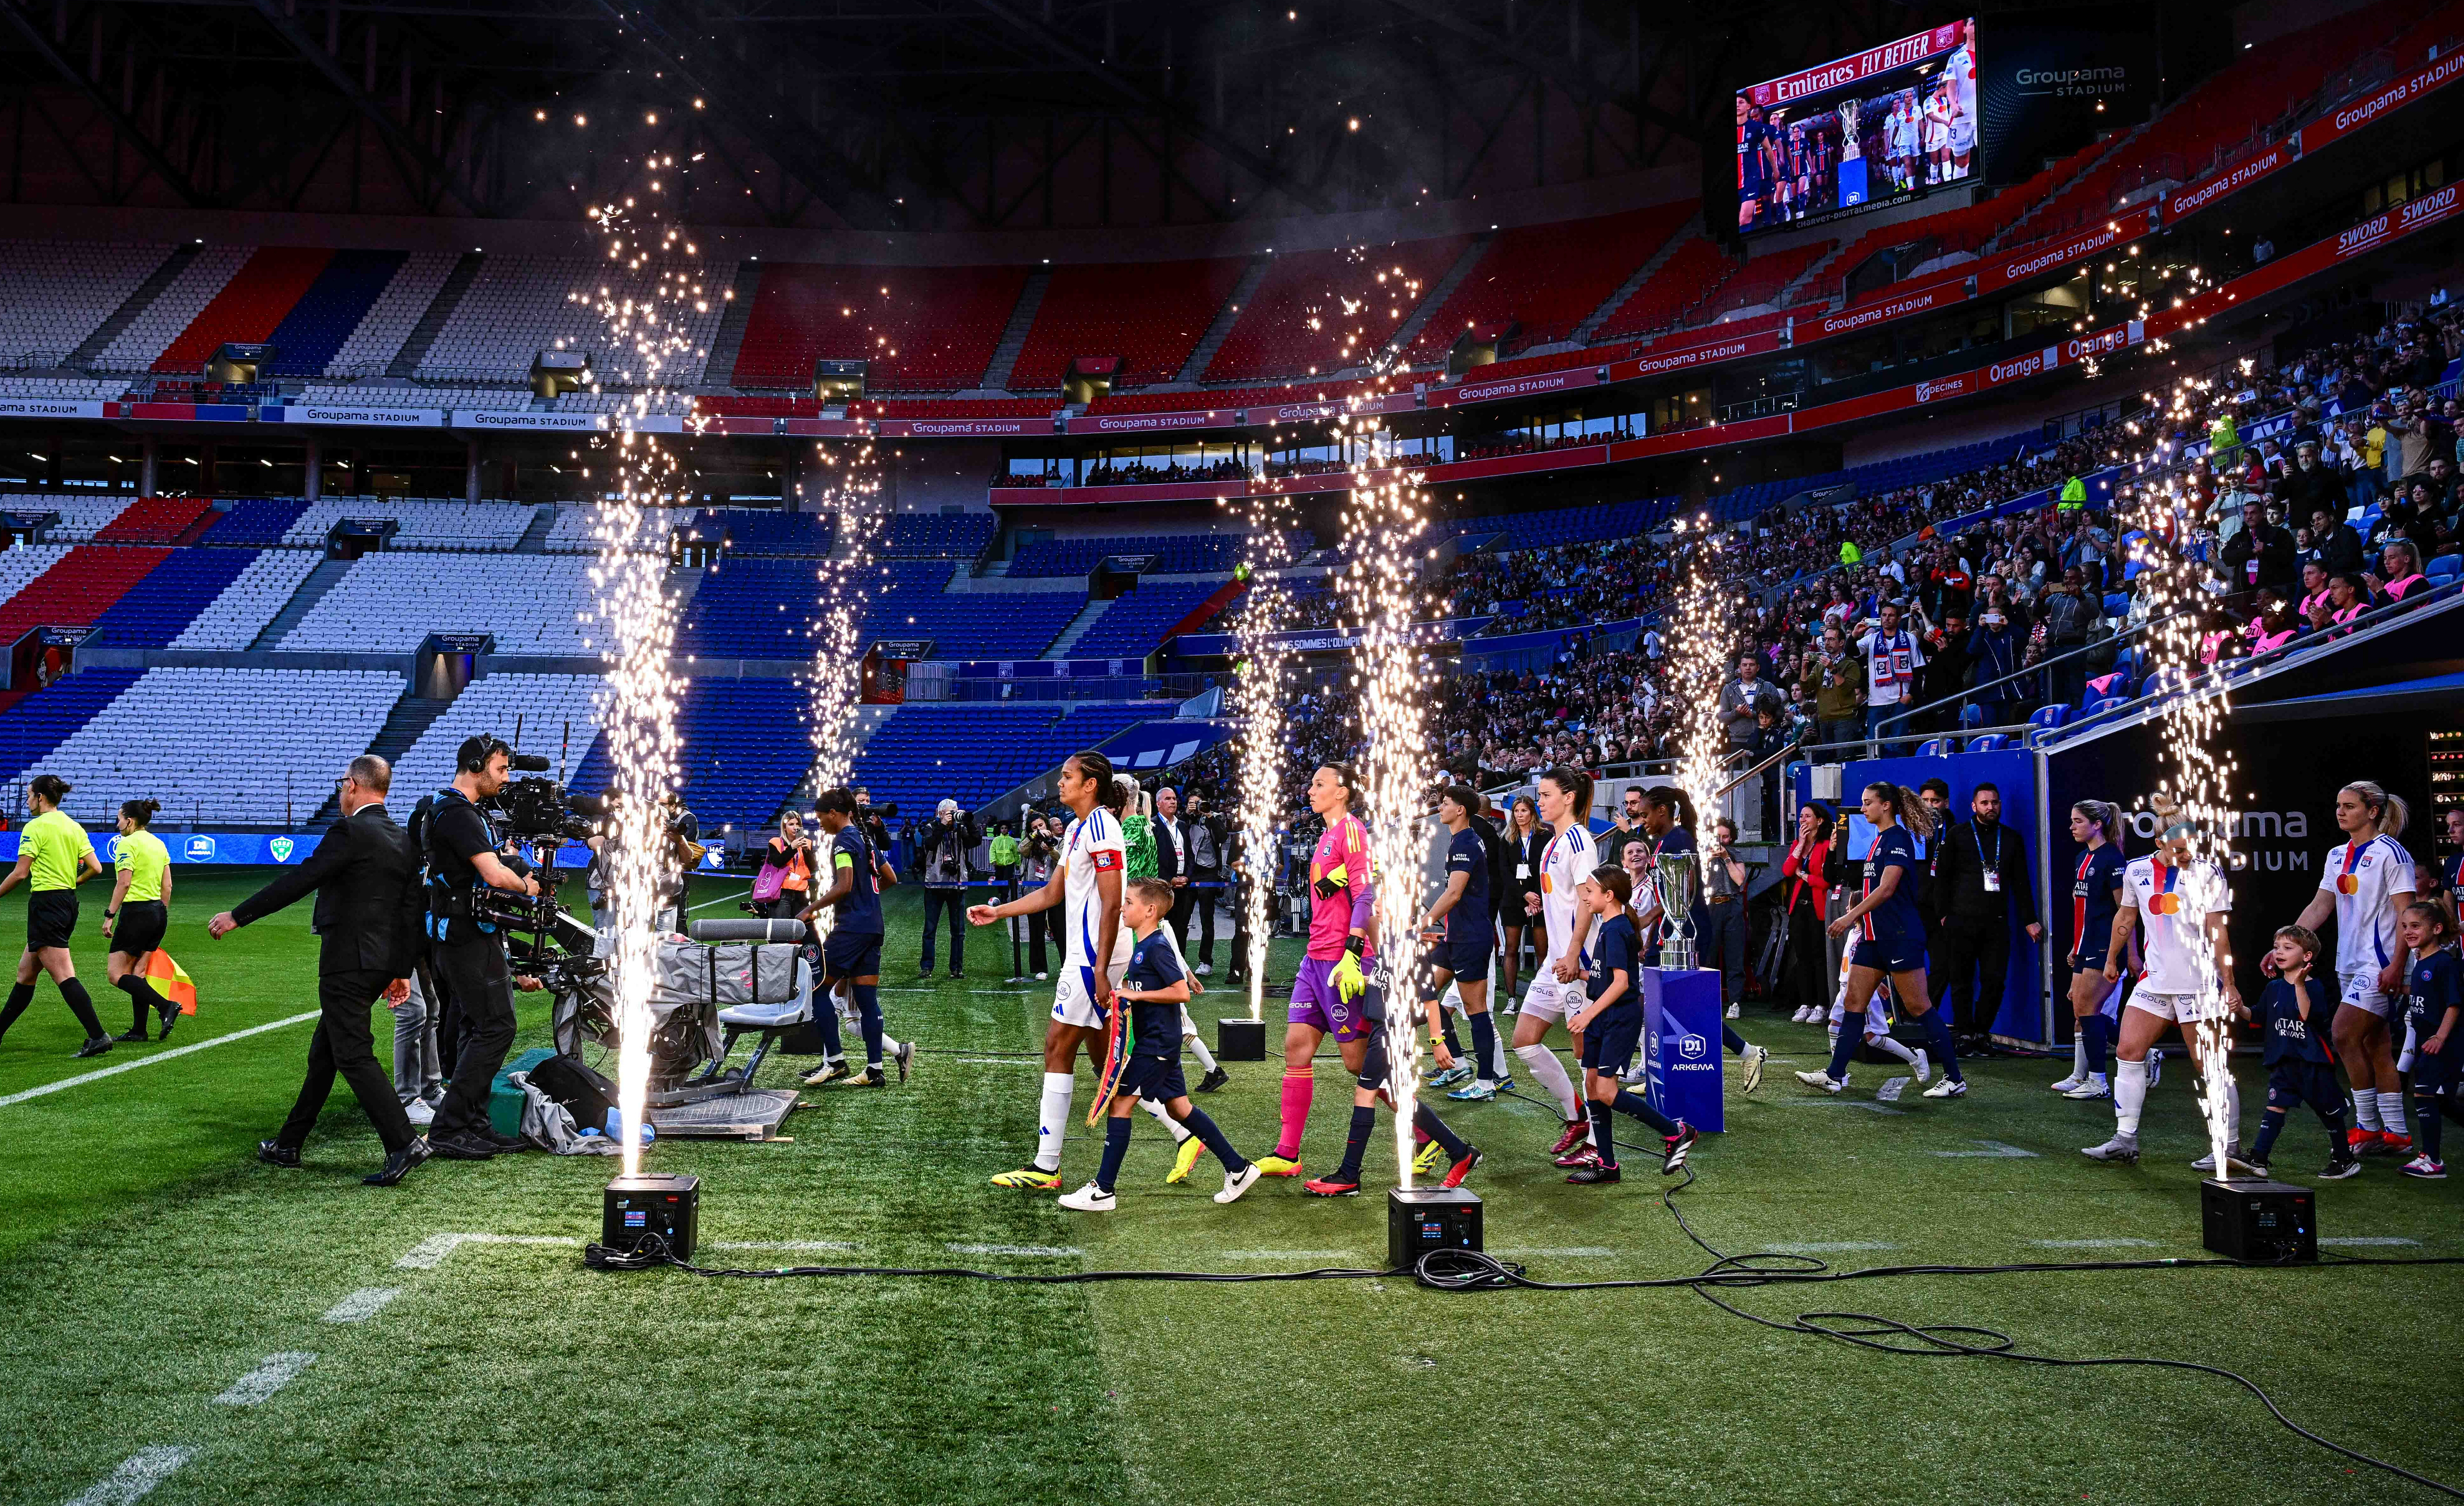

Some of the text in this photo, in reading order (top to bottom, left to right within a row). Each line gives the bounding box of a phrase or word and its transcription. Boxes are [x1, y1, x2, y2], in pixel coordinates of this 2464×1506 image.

[1776, 35, 1929, 101] Emirates FLY BETTER
[2016, 66, 2125, 85] Groupama
[2057, 83, 2125, 96] STADIUM
[2336, 85, 2406, 130] Groupama
[2174, 152, 2277, 213] Groupama STADIUM
[1849, 195, 1857, 203] D1
[2401, 187, 2455, 223] SWORD
[2338, 215, 2388, 249] SWORD
[2007, 231, 2114, 279] Groupama STADIUM
[1824, 295, 1933, 332] Groupama STADIUM
[2068, 330, 2124, 358] Orange
[2128, 335, 2143, 343] orange
[1639, 343, 1745, 372] Groupama STADIUM
[1990, 357, 2040, 382] Orange
[1459, 377, 1564, 400] Groupama STADIUM
[1930, 380, 1963, 394] DECINES
[29, 404, 78, 414] STADIUM
[307, 408, 420, 423] Groupama STADIUM
[1279, 401, 1384, 419] Groupaa STDIUM
[475, 413, 586, 427] Groupama STADIUM
[1100, 416, 1205, 430] Groupama STADIUM
[912, 422, 1021, 435] Groupama STADIUM
[1294, 638, 1327, 650] SOMMES
[1327, 634, 1367, 648] L'OLYMPI
[193, 840, 207, 850] D1
[1323, 847, 1331, 856] OL
[1891, 850, 1908, 858] RWANDA
[2229, 850, 2308, 871] DIUM
[1098, 858, 1110, 866] OL
[1864, 862, 1875, 871] ATAR
[2453, 886, 2464, 895] QAT
[1371, 966, 1389, 983] TAR
[1128, 980, 1142, 991] TAR
[1368, 980, 1388, 991] WAYS
[1651, 1036, 1657, 1049] D1
[1684, 1040, 1701, 1051] D1
[1647, 1059, 1662, 1069] ARKEMA
[1672, 1063, 1715, 1071] ARKEMA
